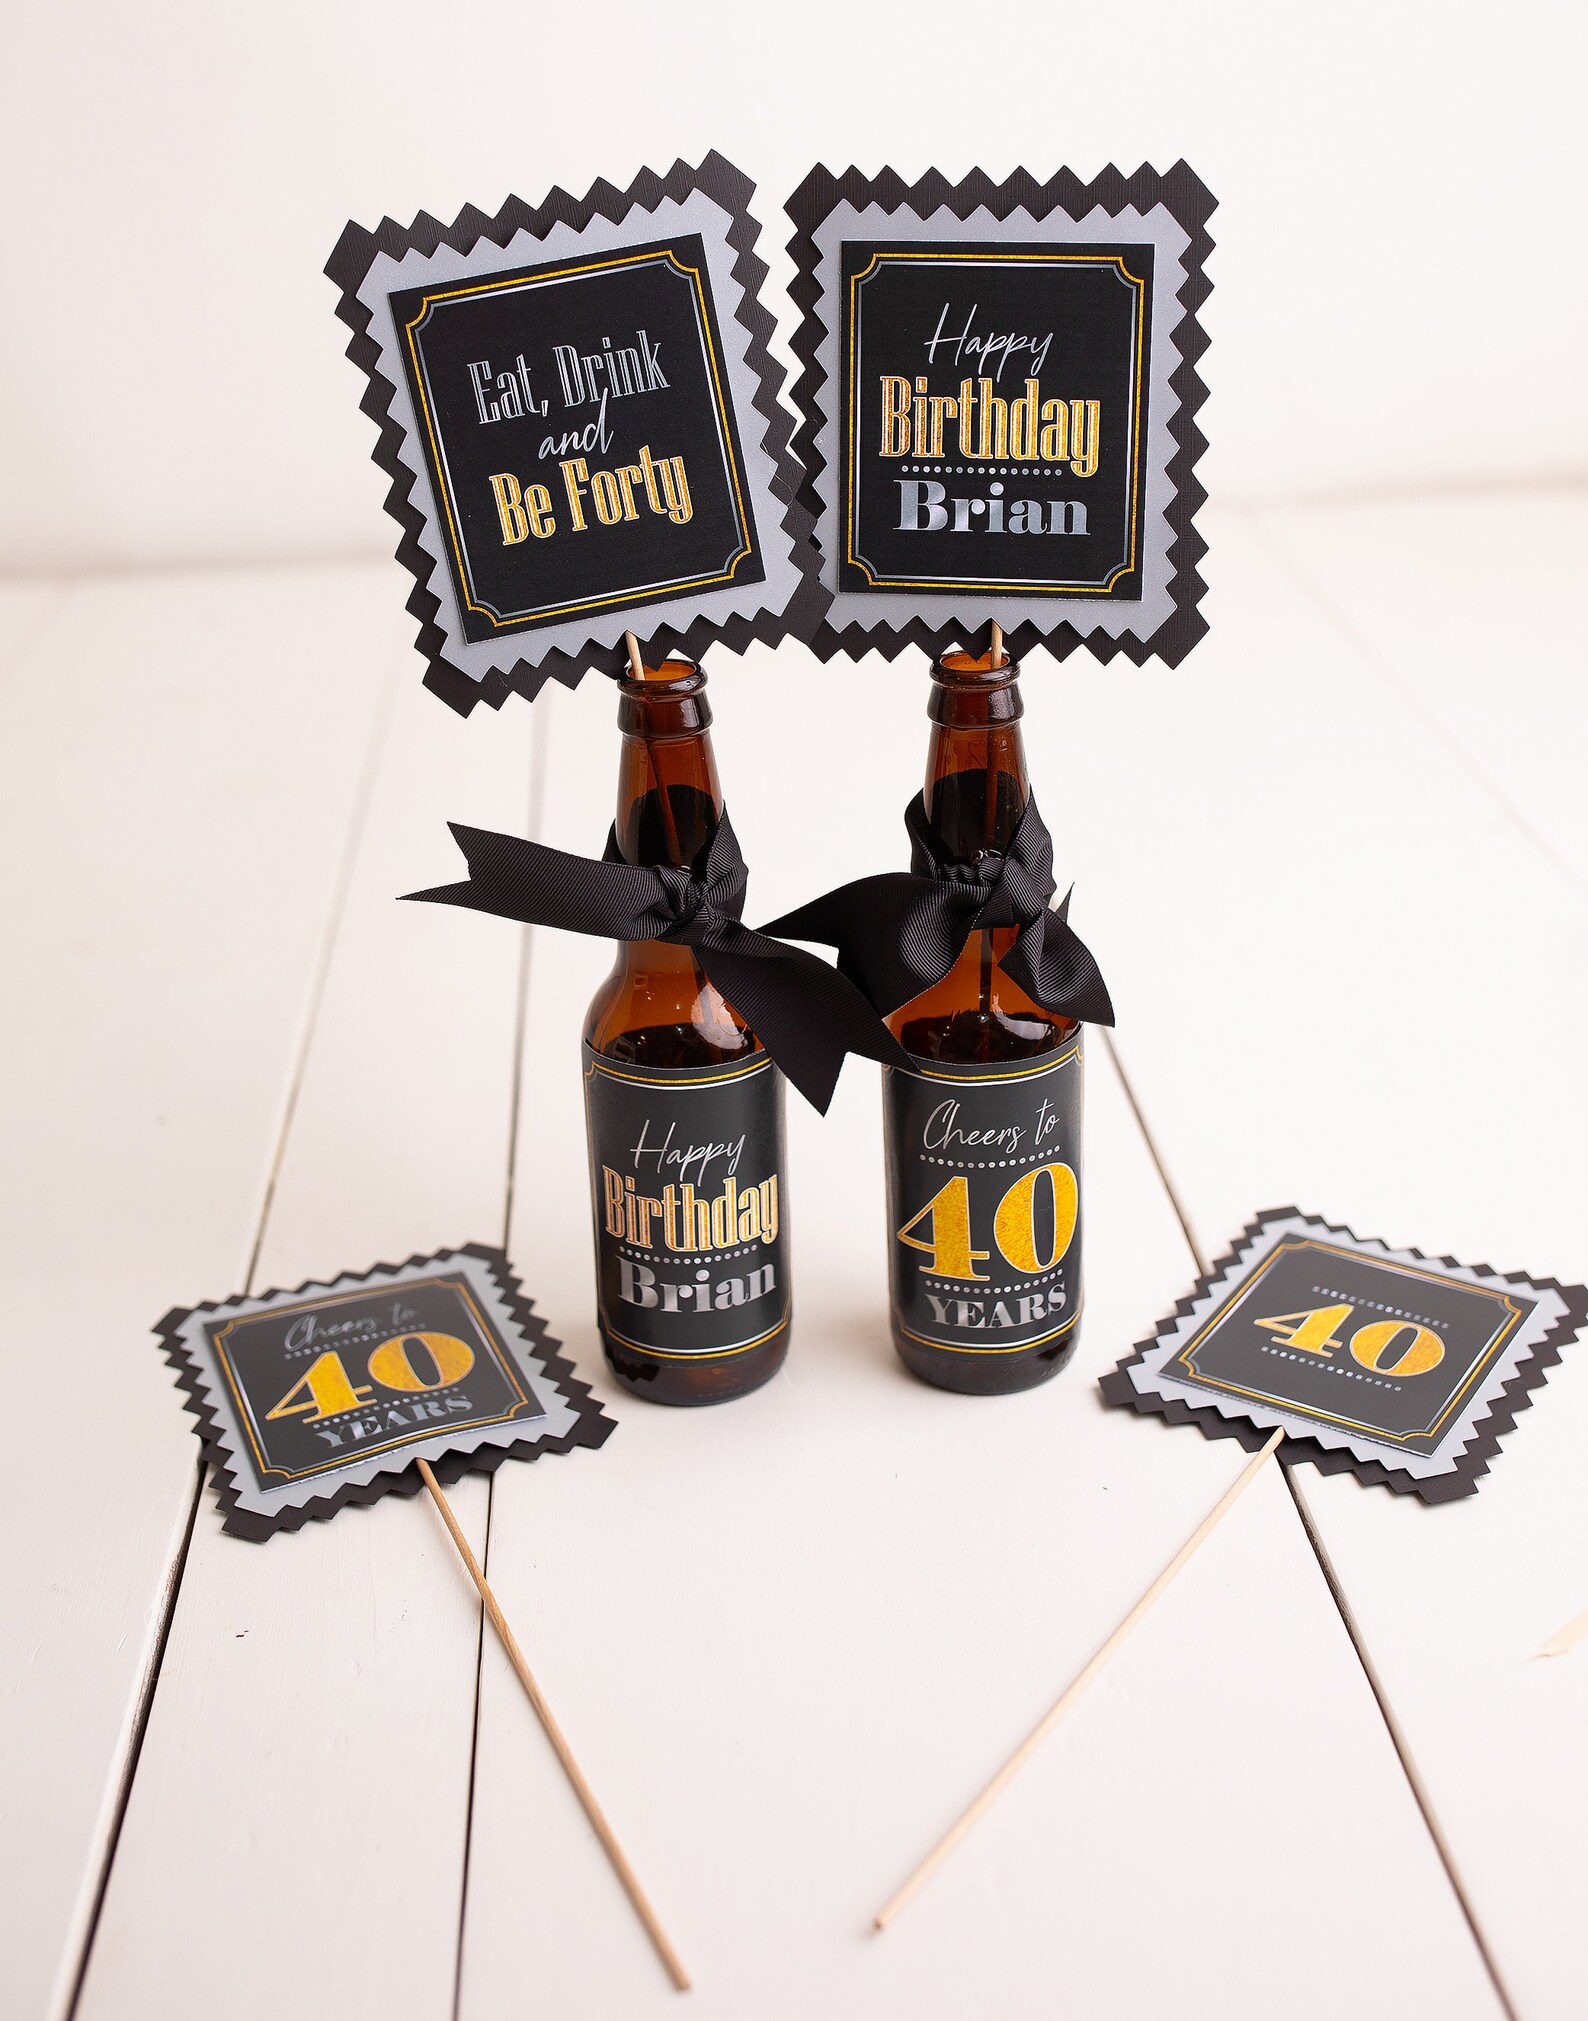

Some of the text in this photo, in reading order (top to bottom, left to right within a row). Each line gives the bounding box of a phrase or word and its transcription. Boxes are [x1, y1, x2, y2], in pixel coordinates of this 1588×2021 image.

[467, 329, 671, 424] Eat, Drink
[923, 302, 1054, 383] Happy
[538, 387, 614, 460] and
[879, 375, 1100, 478] Birthday
[489, 444, 693, 546] Be Forty
[892, 479, 1091, 535] Brian
[630, 1119, 746, 1187] Happy
[923, 1098, 1060, 1154] Cheers to
[602, 1164, 779, 1252] Birthday
[896, 1162, 1078, 1281] 40
[615, 1255, 777, 1313] Brian
[924, 1281, 1067, 1329] YEARS
[1253, 1303, 1446, 1377] 40
[265, 1331, 476, 1424] 40
[313, 1395, 473, 1447] YEARS
